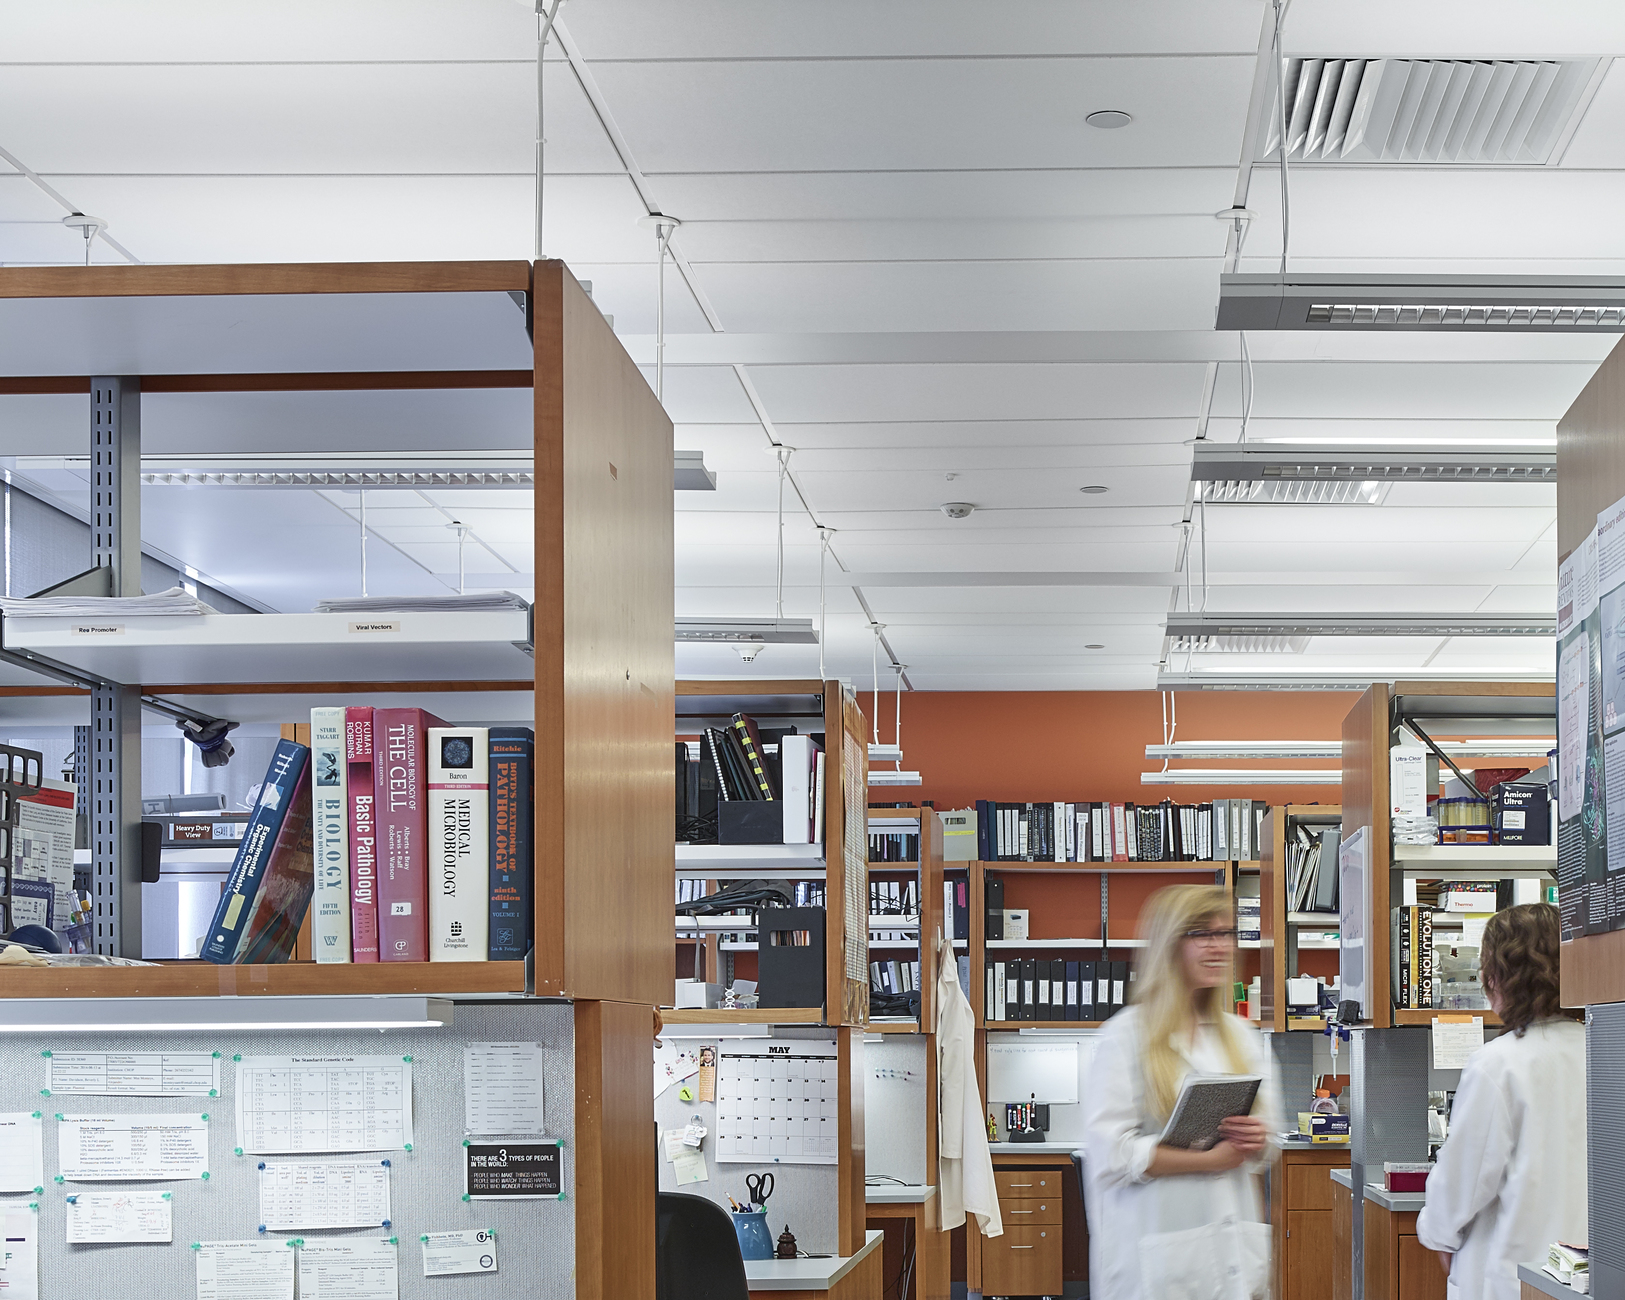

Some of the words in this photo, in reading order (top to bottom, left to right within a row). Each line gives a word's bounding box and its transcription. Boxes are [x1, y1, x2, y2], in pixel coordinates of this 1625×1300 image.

[347, 722, 355, 759] ROBBINS
[355, 722, 363, 755] COTRAN
[389, 724, 405, 762] THE
[390, 765, 407, 812] CELL
[409, 802, 416, 810] OF
[356, 795, 373, 832] Basic
[459, 799, 470, 857] MEDICAL
[496, 763, 509, 872] PATHOLOGY
[509, 801, 517, 856] TEXTBOOK
[248, 826, 270, 877] Experimental
[249, 824, 263, 854] Organic
[325, 799, 341, 890] BIOLOGY
[444, 799, 456, 897] MICROBIOLOGY
[233, 855, 252, 895] Chemistry
[356, 836, 375, 904] Pathology
[509, 857, 516, 871] OF
[1422, 911, 1431, 976] EVOLUTION
[1423, 979, 1431, 1005] ONE
[500, 1149, 507, 1161] 3
